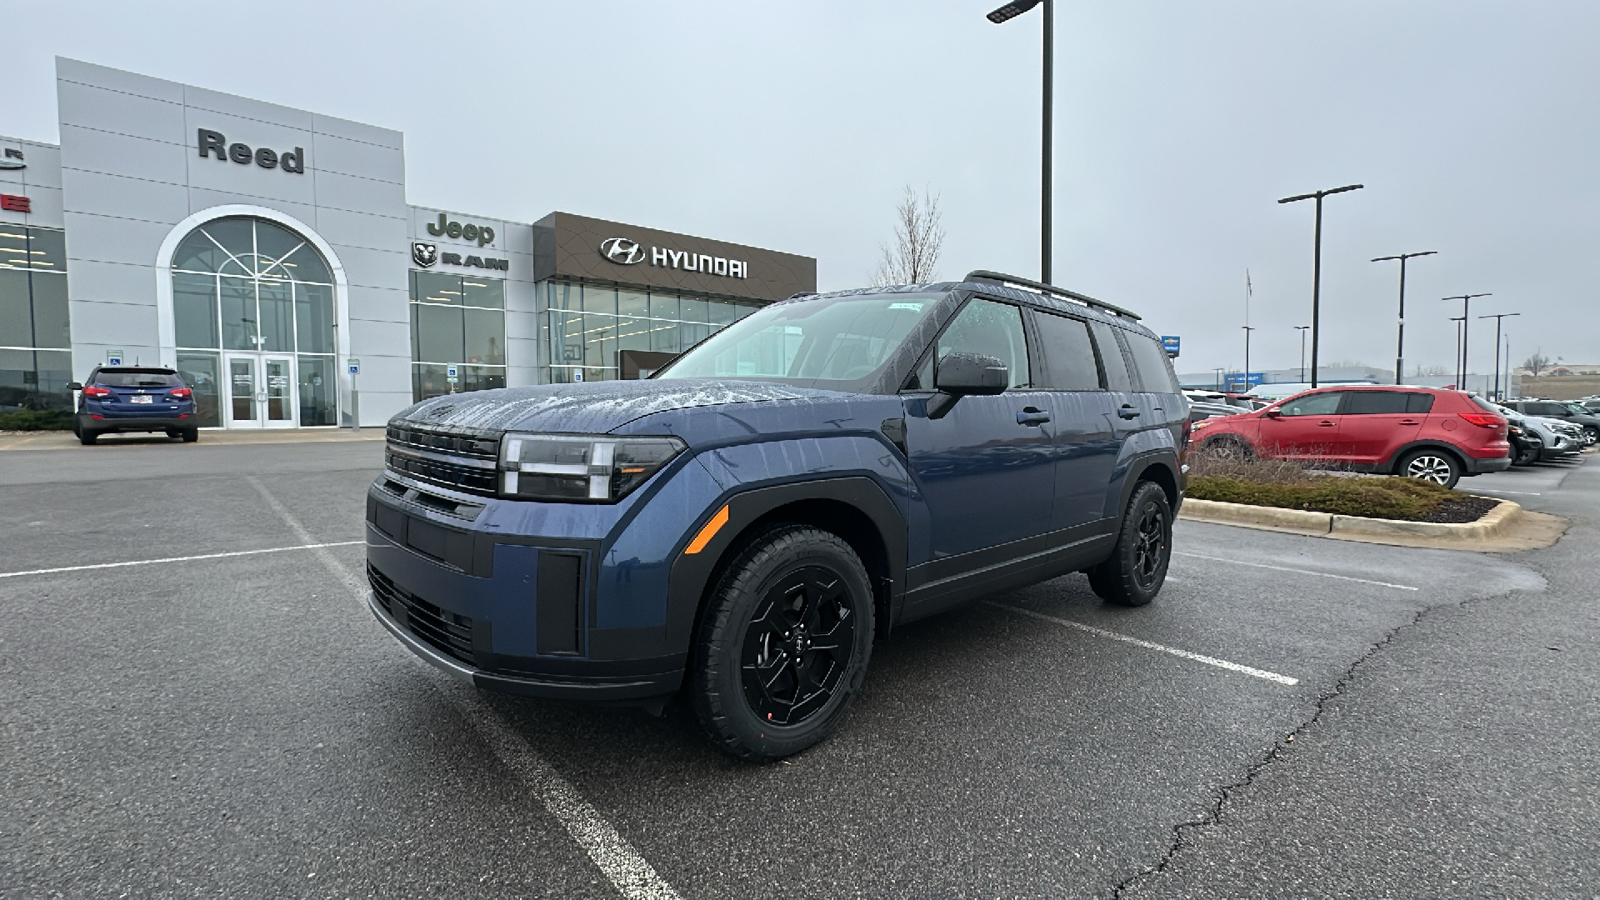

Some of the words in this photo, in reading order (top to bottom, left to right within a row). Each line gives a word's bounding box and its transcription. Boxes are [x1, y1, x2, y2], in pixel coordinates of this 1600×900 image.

[198, 127, 304, 174] Reed
[426, 212, 495, 248] Jeep
[441, 252, 509, 271] RAM
[650, 246, 748, 279] HYUNDAI
